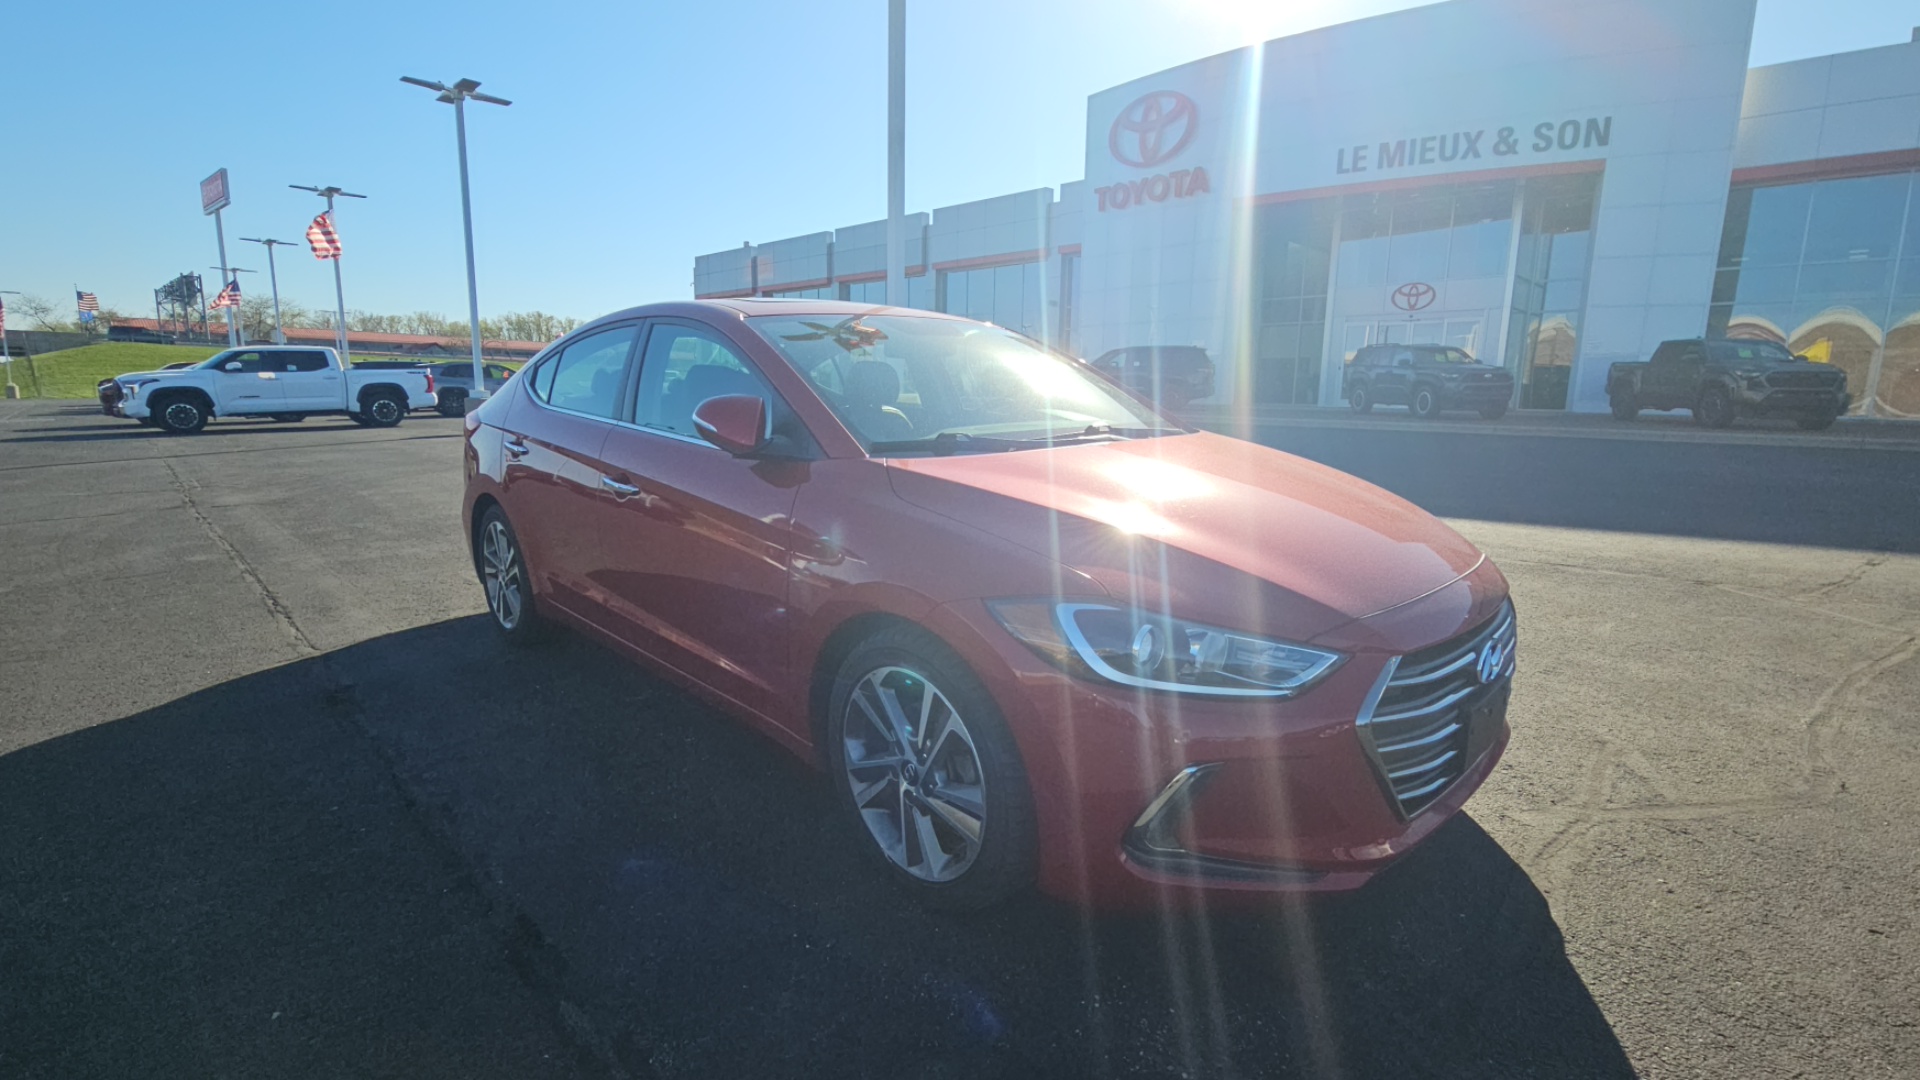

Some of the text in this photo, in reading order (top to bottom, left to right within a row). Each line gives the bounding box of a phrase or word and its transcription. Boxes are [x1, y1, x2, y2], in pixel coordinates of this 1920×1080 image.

[1336, 116, 1612, 175] LE MIEUX & SON
[1094, 167, 1210, 213] TOYOTA
